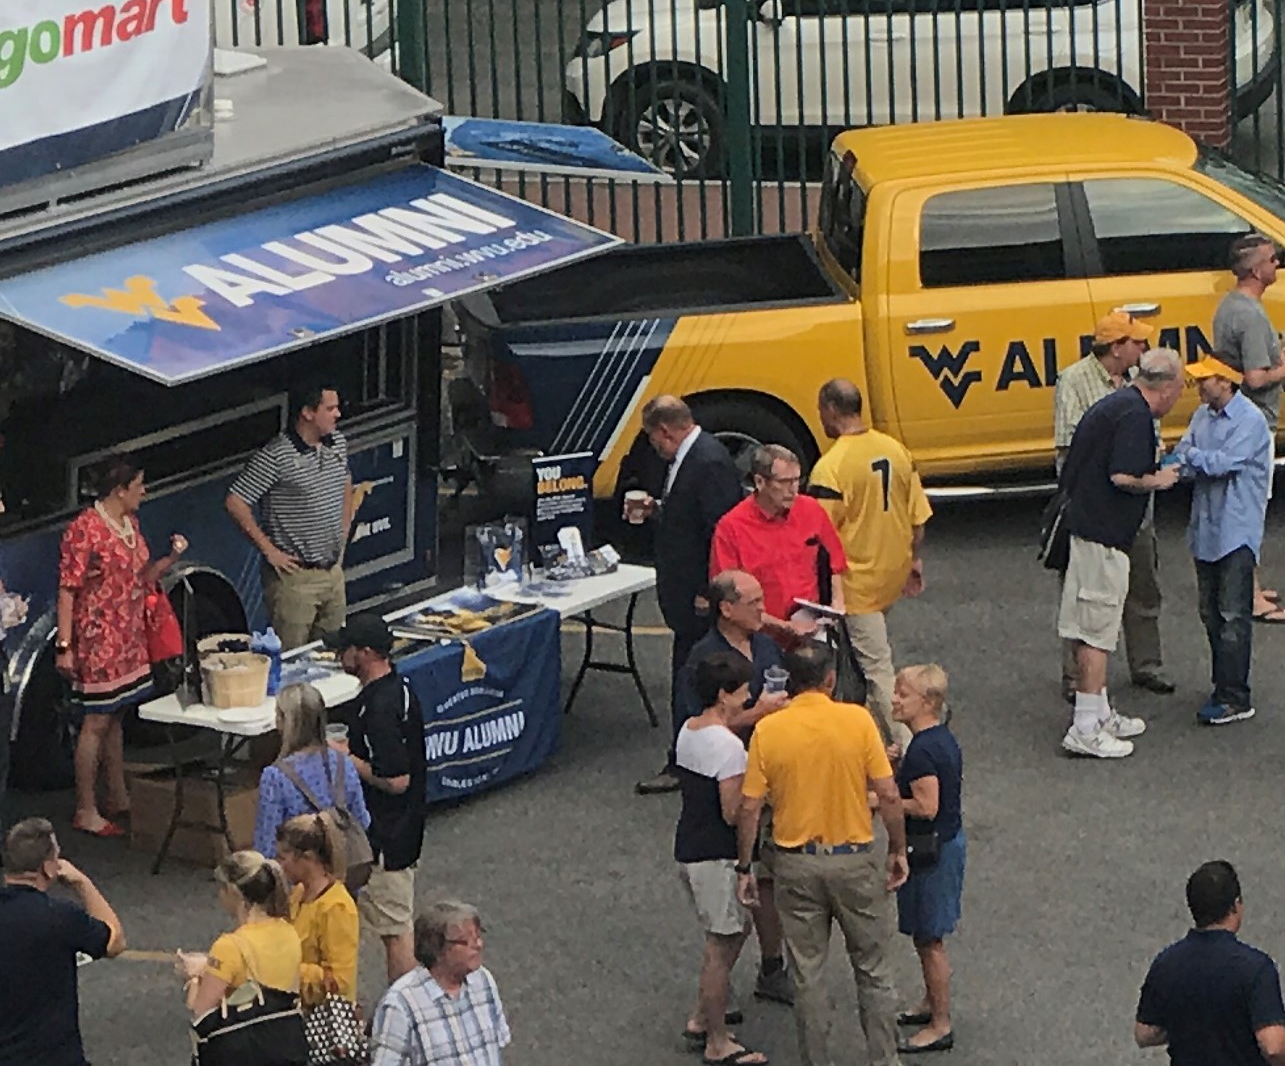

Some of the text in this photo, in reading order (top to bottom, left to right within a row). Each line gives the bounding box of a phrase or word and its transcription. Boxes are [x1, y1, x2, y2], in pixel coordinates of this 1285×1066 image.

[182, 192, 517, 308] ALUMNI
[384, 229, 553, 287] alumni.wvu.edu
[536, 465, 561, 481] YOU
[462, 710, 526, 754] ALUMNI
